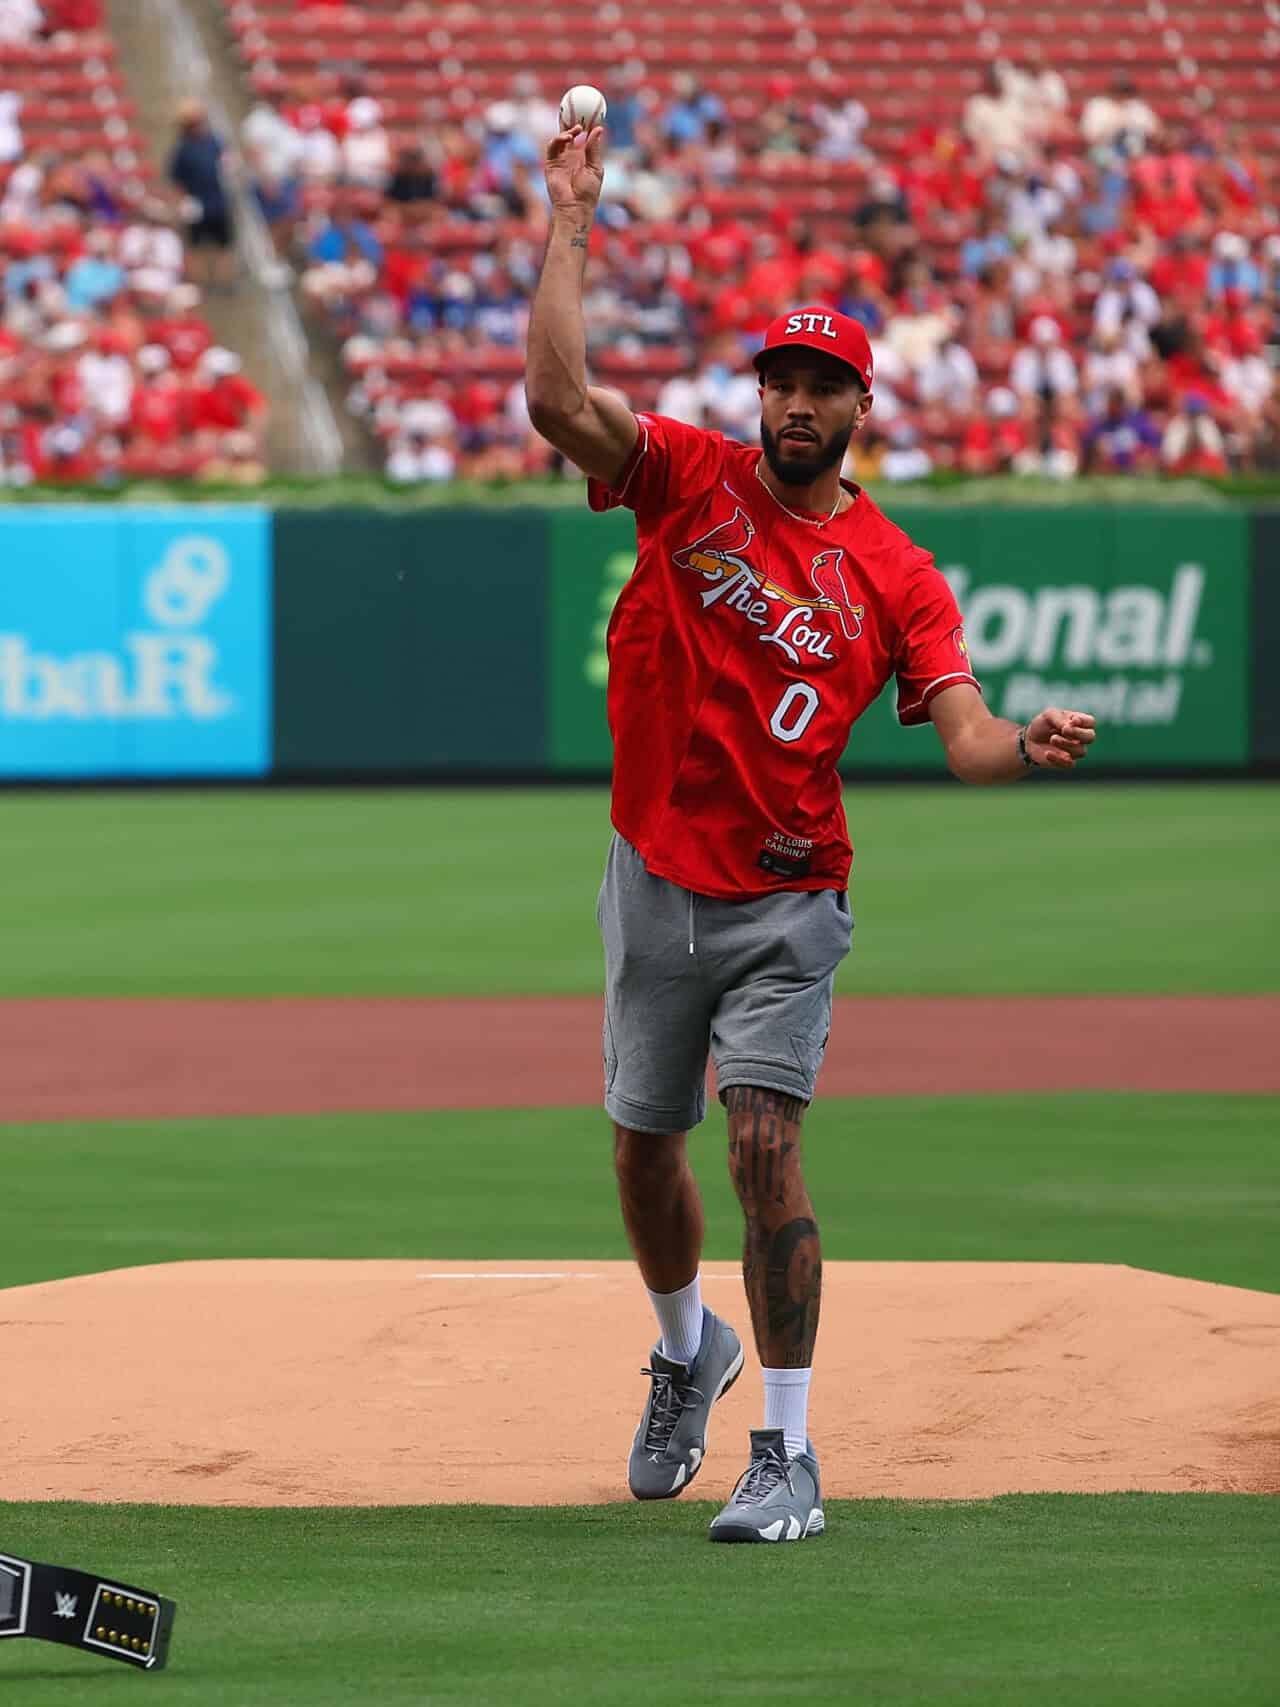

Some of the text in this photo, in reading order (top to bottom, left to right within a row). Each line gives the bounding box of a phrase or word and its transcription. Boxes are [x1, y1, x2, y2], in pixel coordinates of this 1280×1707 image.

[784, 312, 838, 339] STL
[700, 556, 835, 665] The Lou
[769, 681, 820, 743] 0
[786, 837, 813, 849] LOUIS
